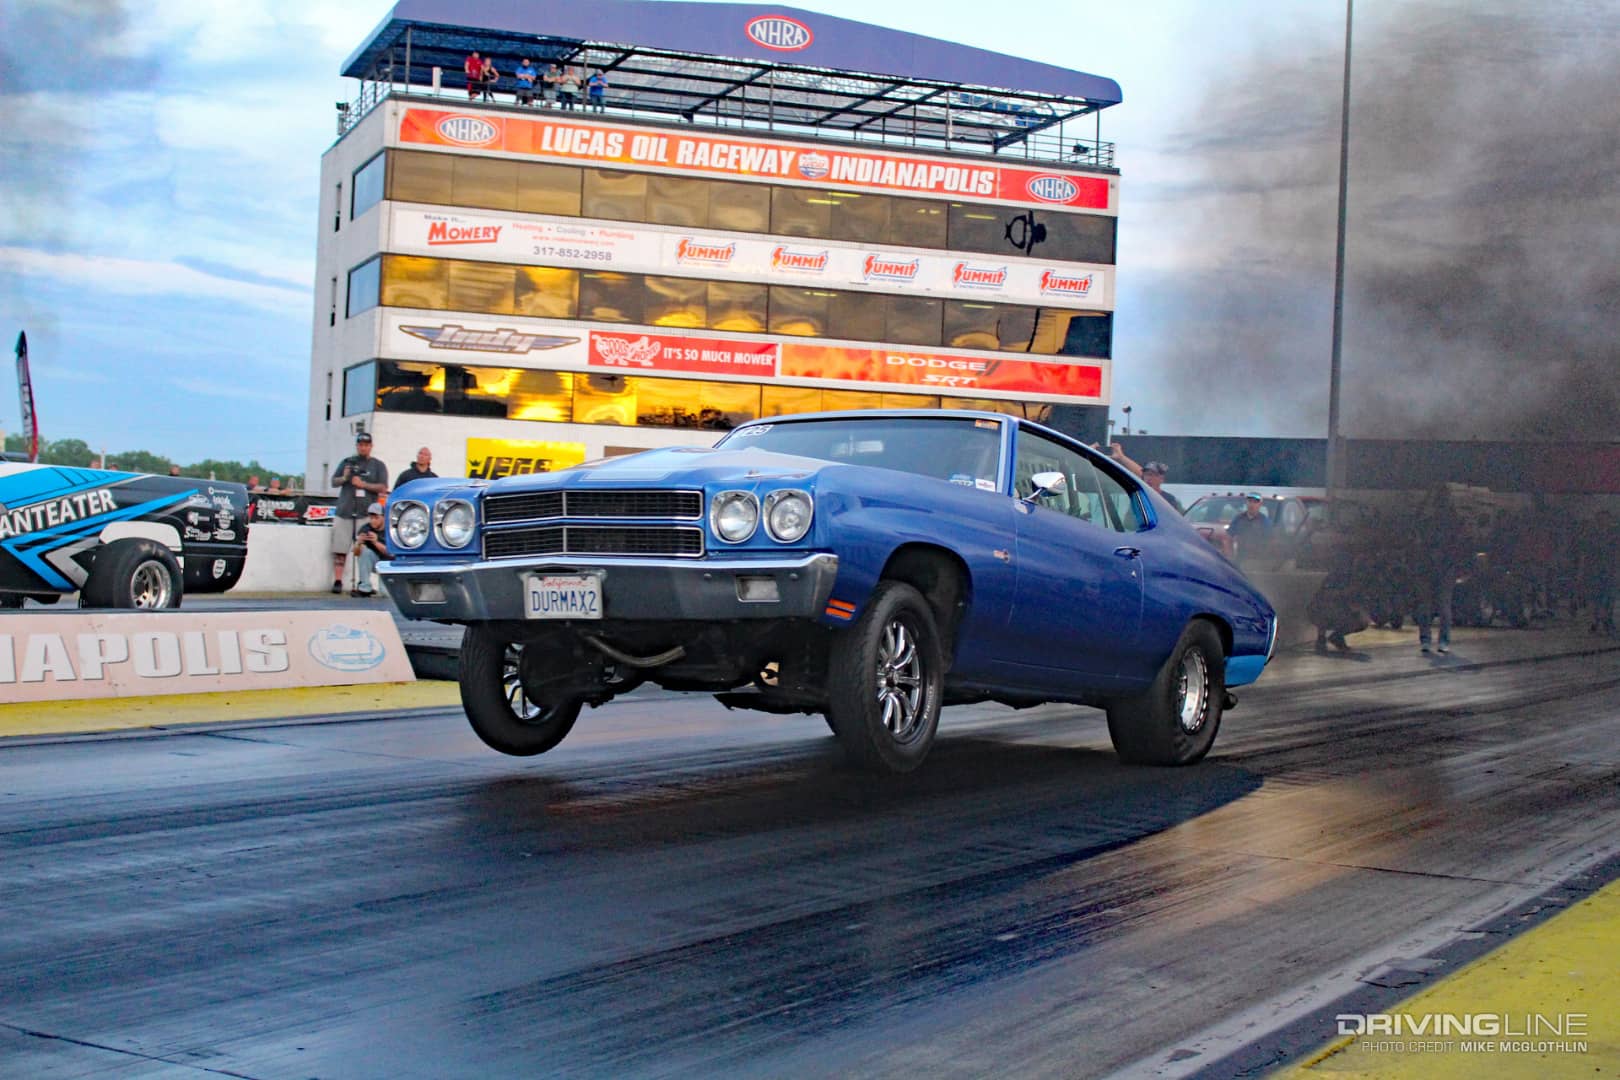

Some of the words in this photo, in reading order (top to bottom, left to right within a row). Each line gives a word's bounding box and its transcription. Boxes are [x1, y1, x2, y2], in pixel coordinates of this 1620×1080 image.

[754, 21, 804, 46] NHRA
[446, 120, 491, 141] NHRA
[541, 126, 625, 158] LUCAS
[630, 135, 668, 163] OIL
[676, 140, 796, 175] RACEWAY
[831, 156, 994, 195] INDIANAPOLIS
[1035, 179, 1075, 199] NHRA
[428, 222, 502, 241] MOWERY
[533, 246, 612, 261] 317-852-2958
[663, 347, 682, 360] IT'S
[685, 349, 698, 360] SO
[702, 350, 731, 364] MUCH
[734, 351, 773, 366] MOWER
[886, 356, 986, 371] DODGE
[922, 374, 977, 387] SRT
[0, 489, 118, 539] ANTEATER
[531, 590, 597, 612] DURMAX2
